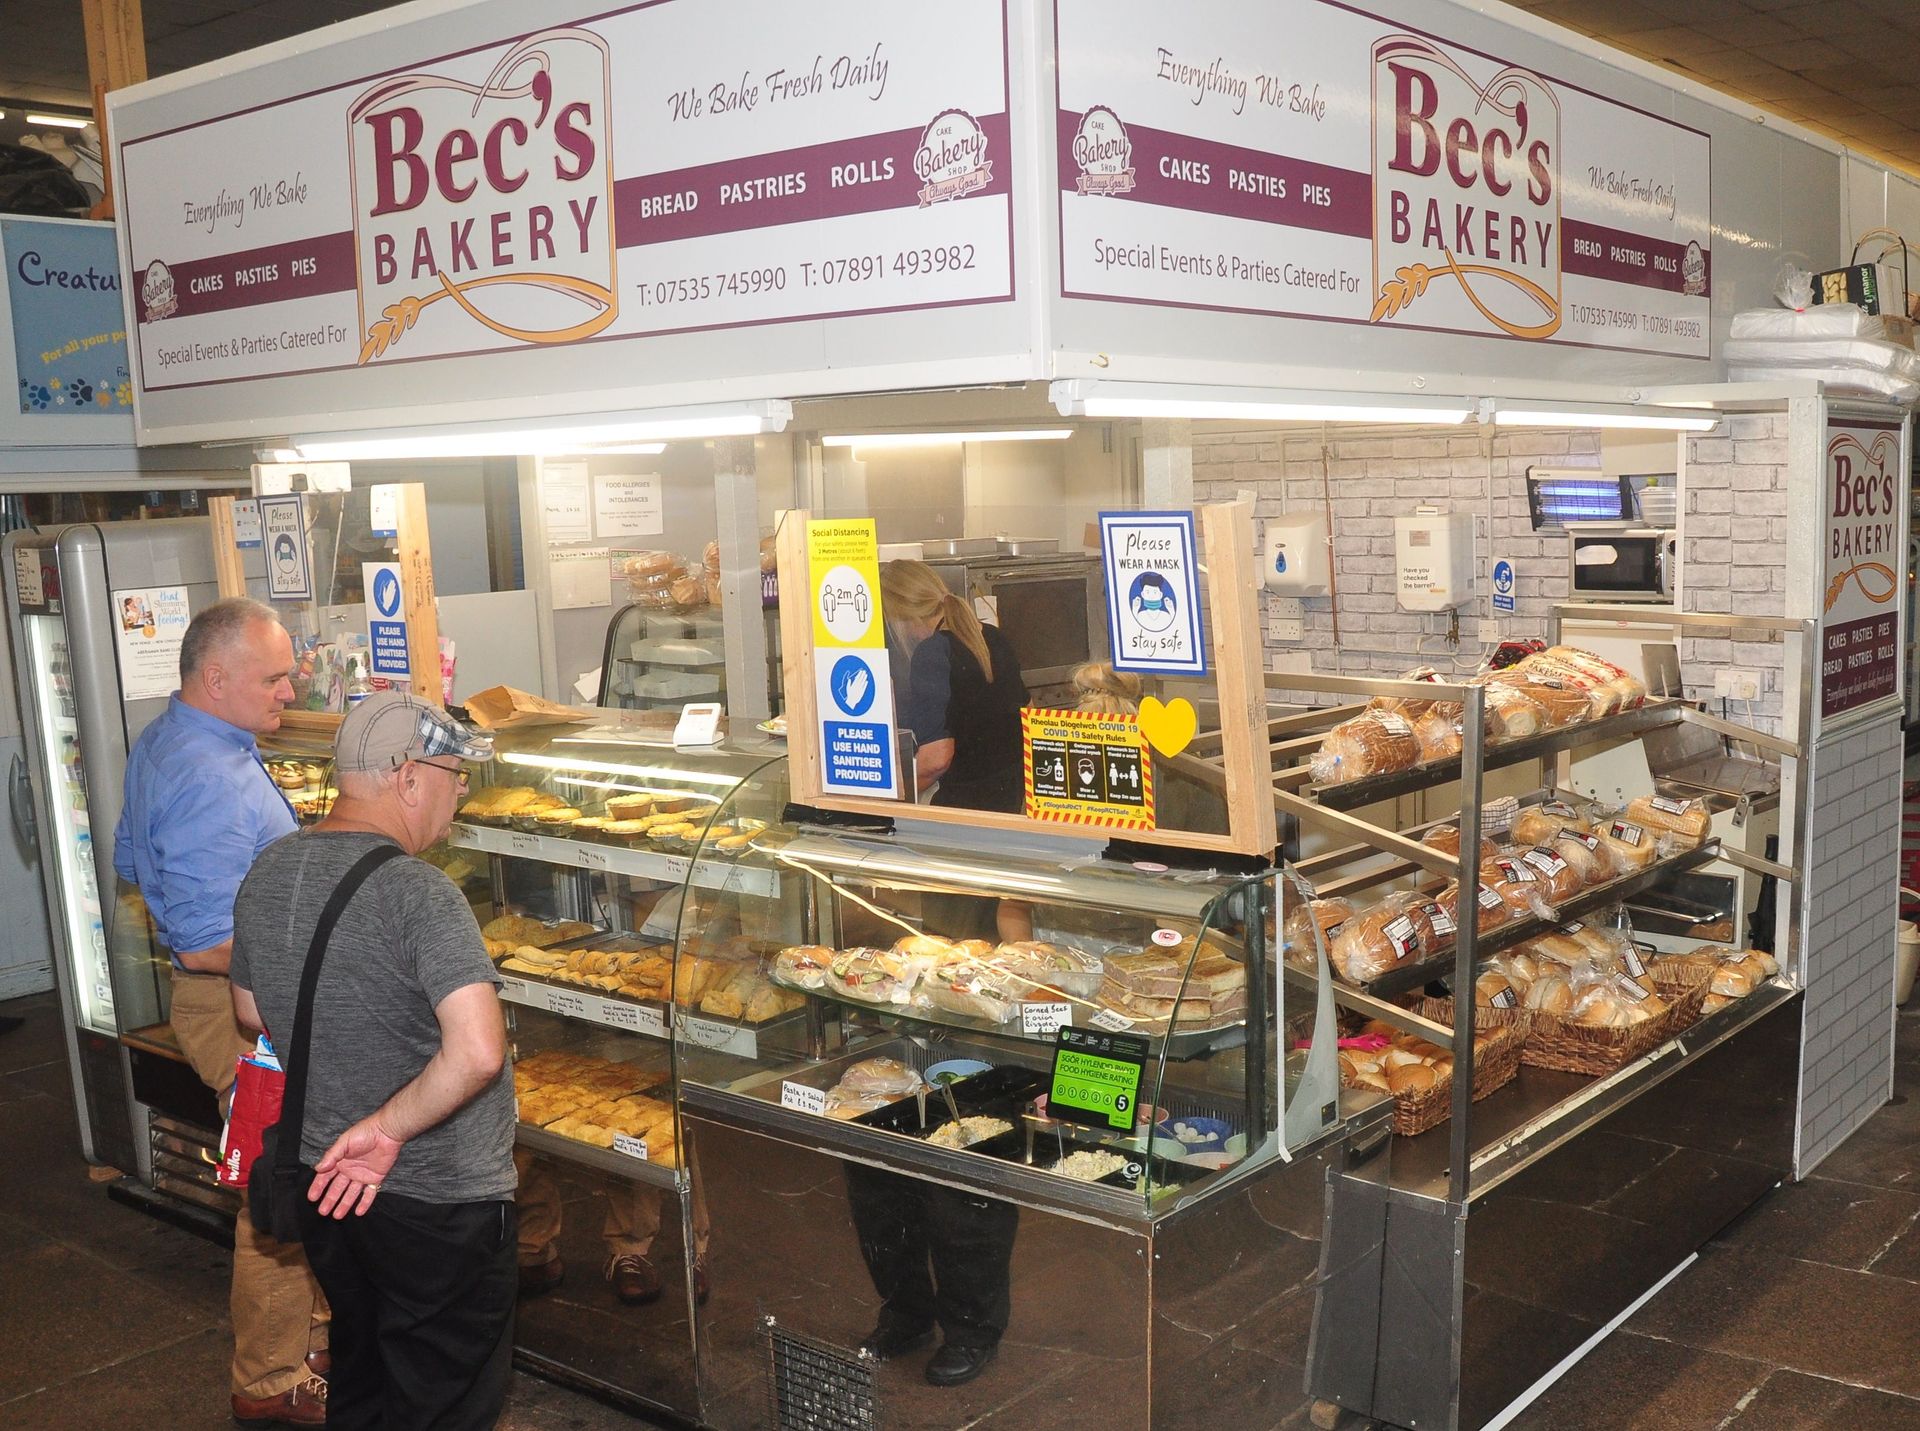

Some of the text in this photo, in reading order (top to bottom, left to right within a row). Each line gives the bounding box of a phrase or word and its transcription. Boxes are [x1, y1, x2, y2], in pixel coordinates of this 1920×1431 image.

[668, 42, 889, 122] We Bake Fresh Daily
[1156, 47, 1326, 122] Everything We Bake
[936, 126, 952, 136] CAKE
[1091, 121, 1104, 130] CAKE
[1388, 61, 1552, 206] Bec's
[365, 70, 596, 218] Bec's
[916, 133, 984, 178] Bakery
[1075, 134, 1129, 169] Bakery
[948, 166, 967, 176] SHOP
[1101, 163, 1116, 172] SHOP
[1159, 156, 1331, 207] CAKES PASTIES PIES
[640, 157, 895, 218] BREAD PASTRIES ROLLS
[1588, 166, 1676, 221] We Bake Fresh Daily
[184, 172, 307, 233] Everything We Bake
[374, 196, 598, 285] BAKERY
[1390, 190, 1552, 268] BAKERY
[1094, 238, 1360, 293] Special Events & Parties Catered For
[1574, 238, 1677, 273] BREAD PASTRIES ROLLS
[190, 257, 317, 294] CAKES PASTIES PIES
[637, 244, 976, 306] T: 07535 745990 T: 07891 493982
[1571, 304, 1700, 338] T: 07535 745990 T: 07891 493982
[41, 332, 109, 364] For all your
[158, 326, 347, 369] Special Events & Parties Catered For
[1833, 455, 1893, 517] Bec's
[812, 528, 869, 537] Social Distancing
[1833, 524, 1893, 559] BAKERY
[1118, 559, 1180, 570] WEAR A MASK
[160, 591, 178, 601] that
[837, 588, 852, 599] 2m
[158, 614, 188, 628] feeling!
[379, 627, 400, 636] PLEASE
[376, 637, 405, 647] USE HAND
[1132, 629, 1183, 657] stay safe
[1829, 622, 1890, 650] CAKES PASTIES PIES
[377, 648, 407, 658] SANITISER
[378, 659, 407, 669] PROVIDED
[1824, 644, 1894, 676] BREAD PASTRIES ROLLS
[838, 728, 874, 740] PLEASE
[1031, 718, 1138, 733] Rheolau Diogelwch COVID 19
[1043, 728, 1126, 743] COVID 19 Safety Rules
[833, 741, 880, 754] USE HAND
[833, 755, 882, 768] SANITISER
[835, 769, 881, 781] PROVIDED
[1060, 1064, 1133, 1085] FOOD HYGIENE RATING
[784, 1083, 800, 1096] Pasta
[1117, 1097, 1126, 1110] 5
[227, 1148, 241, 1181] wilko
